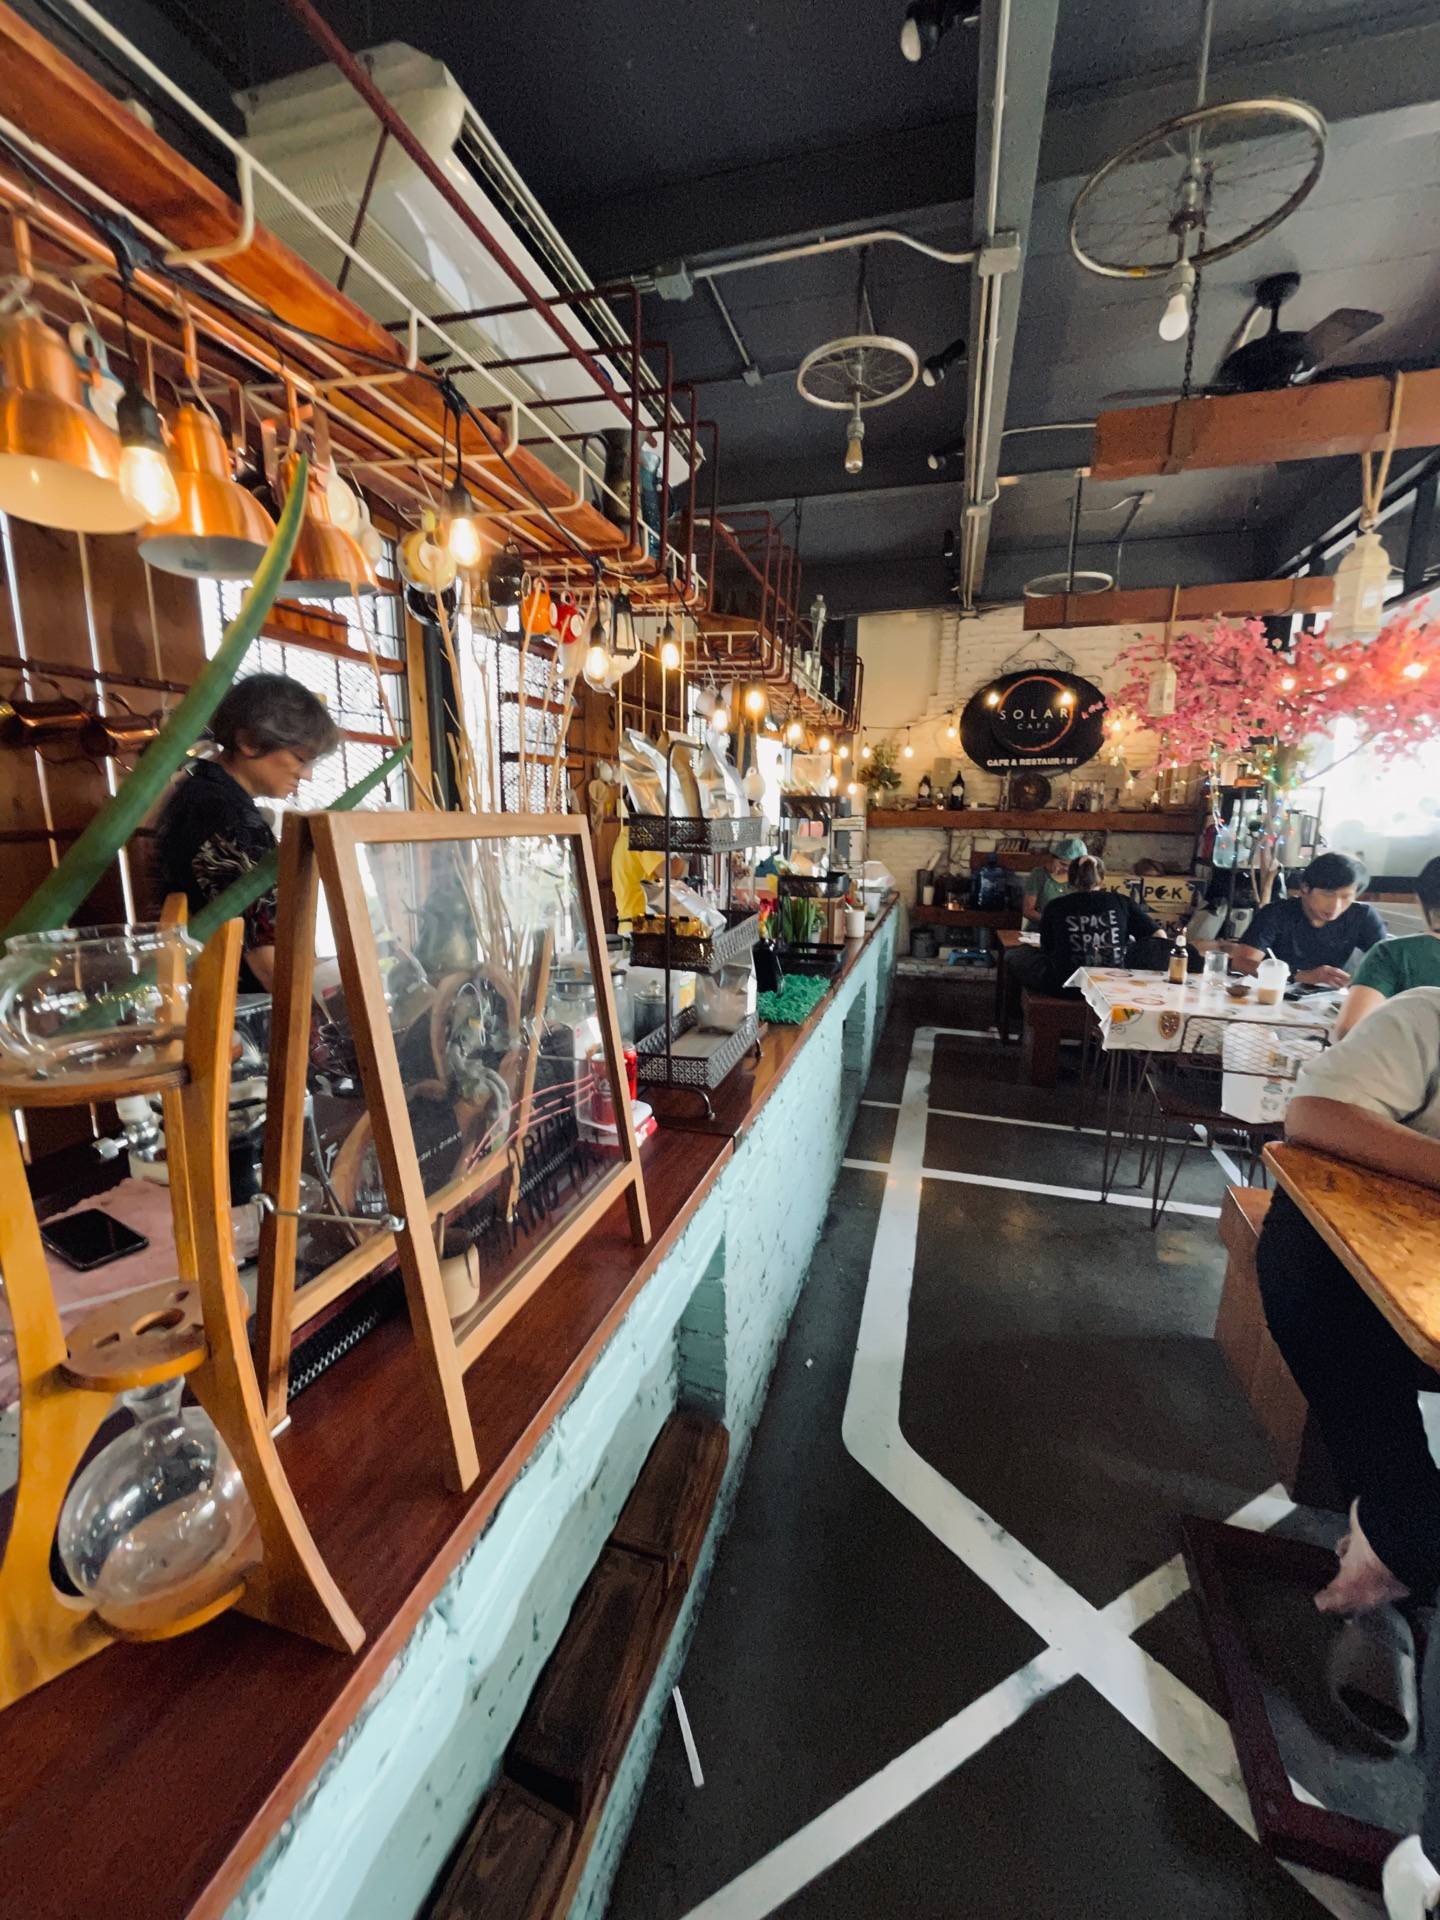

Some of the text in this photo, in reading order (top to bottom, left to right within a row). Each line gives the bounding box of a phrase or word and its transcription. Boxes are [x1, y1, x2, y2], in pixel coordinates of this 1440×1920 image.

[1000, 708, 1068, 720] SOLAR
[987, 759, 1009, 767] CAFE
[1019, 758, 1078, 766] RESTAURANT
[1065, 910, 1118, 932] SPACE
